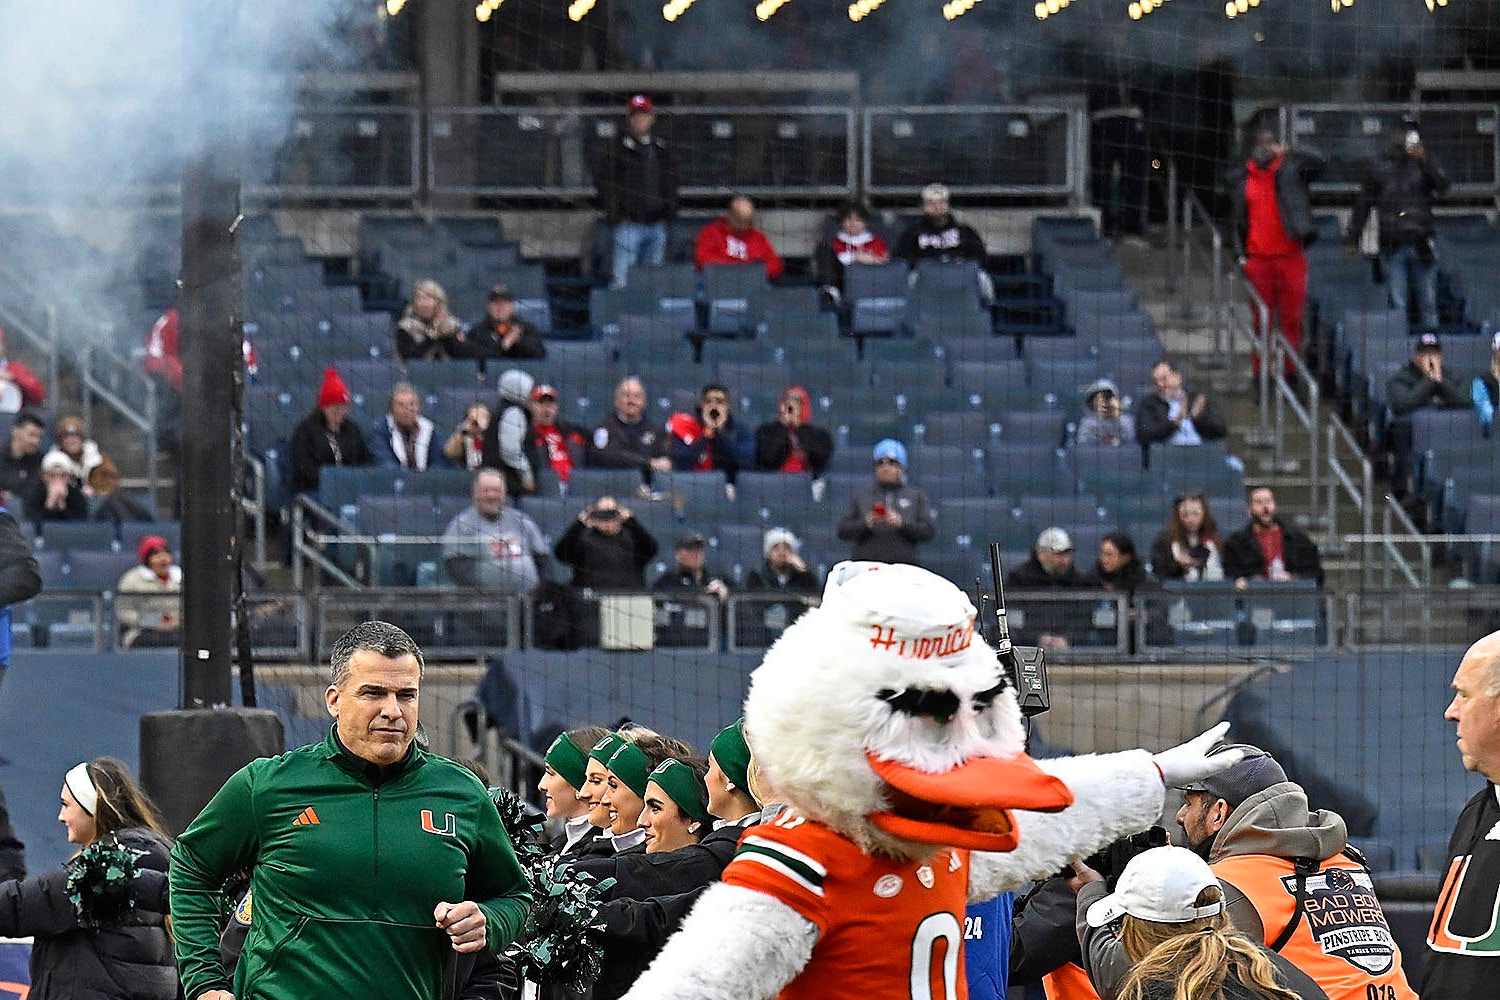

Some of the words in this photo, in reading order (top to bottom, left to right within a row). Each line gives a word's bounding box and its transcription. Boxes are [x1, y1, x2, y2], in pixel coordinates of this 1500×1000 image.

[421, 809, 456, 838] U
[1304, 894, 1349, 913] BAD
[1351, 893, 1382, 910] BOY
[1426, 854, 1500, 957] U
[963, 916, 983, 940] 24
[1310, 907, 1387, 928] MOWERS
[1323, 929, 1374, 951] PINSTRIPE
